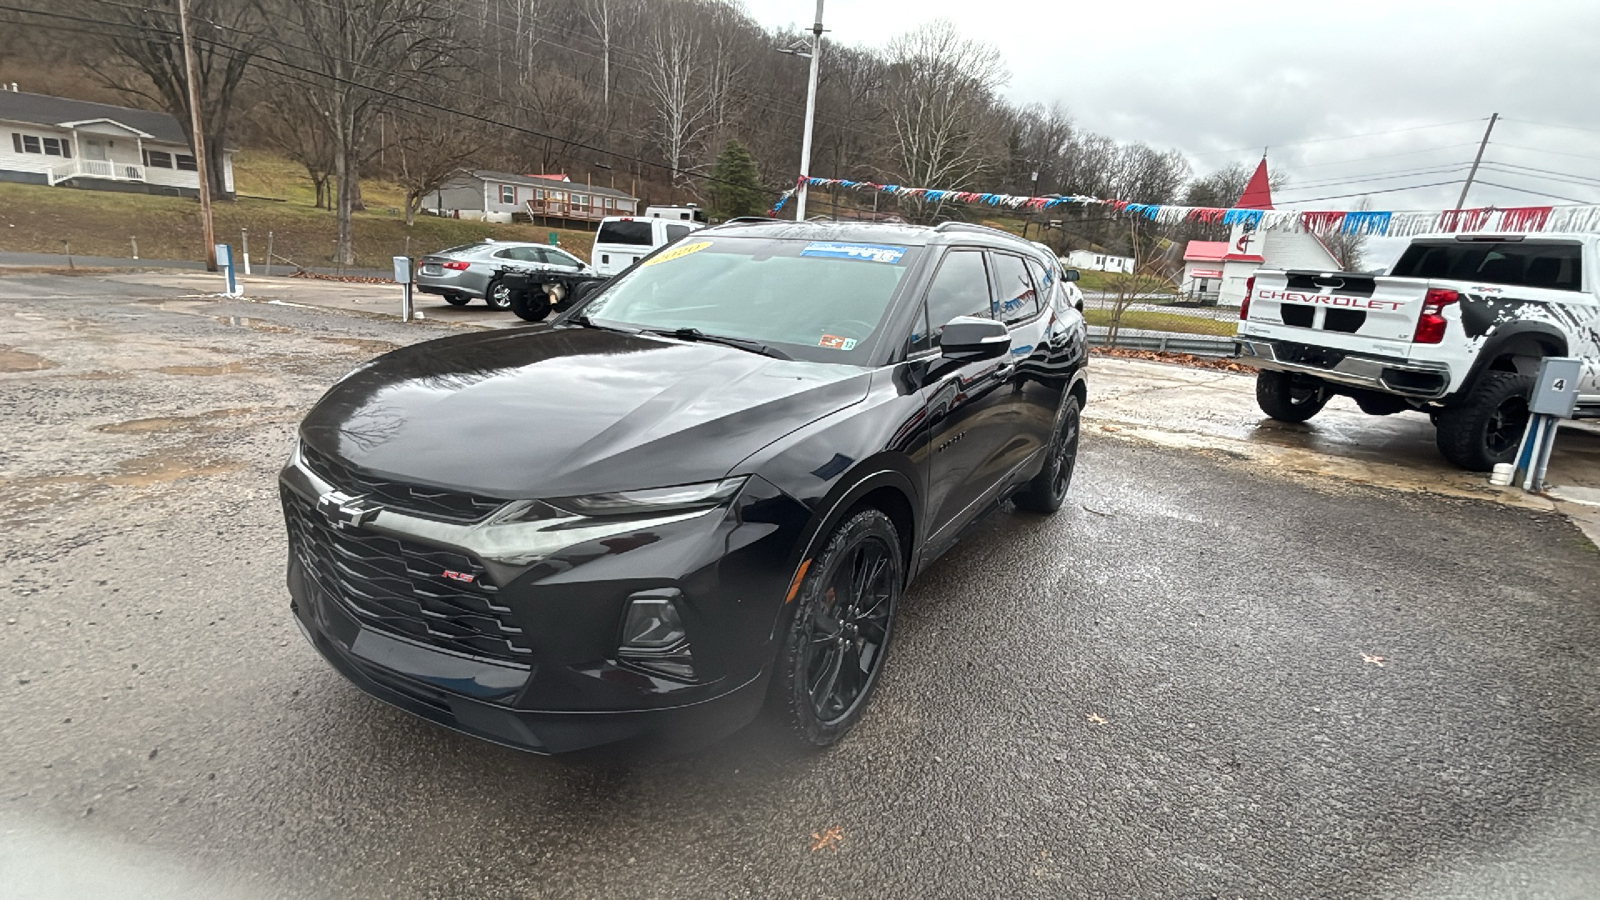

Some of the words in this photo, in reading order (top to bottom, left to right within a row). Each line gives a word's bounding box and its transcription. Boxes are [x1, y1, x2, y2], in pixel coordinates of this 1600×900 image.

[1259, 290, 1406, 311] CHEVROLET
[1553, 379, 1565, 391] 4
[442, 570, 475, 582] RS
